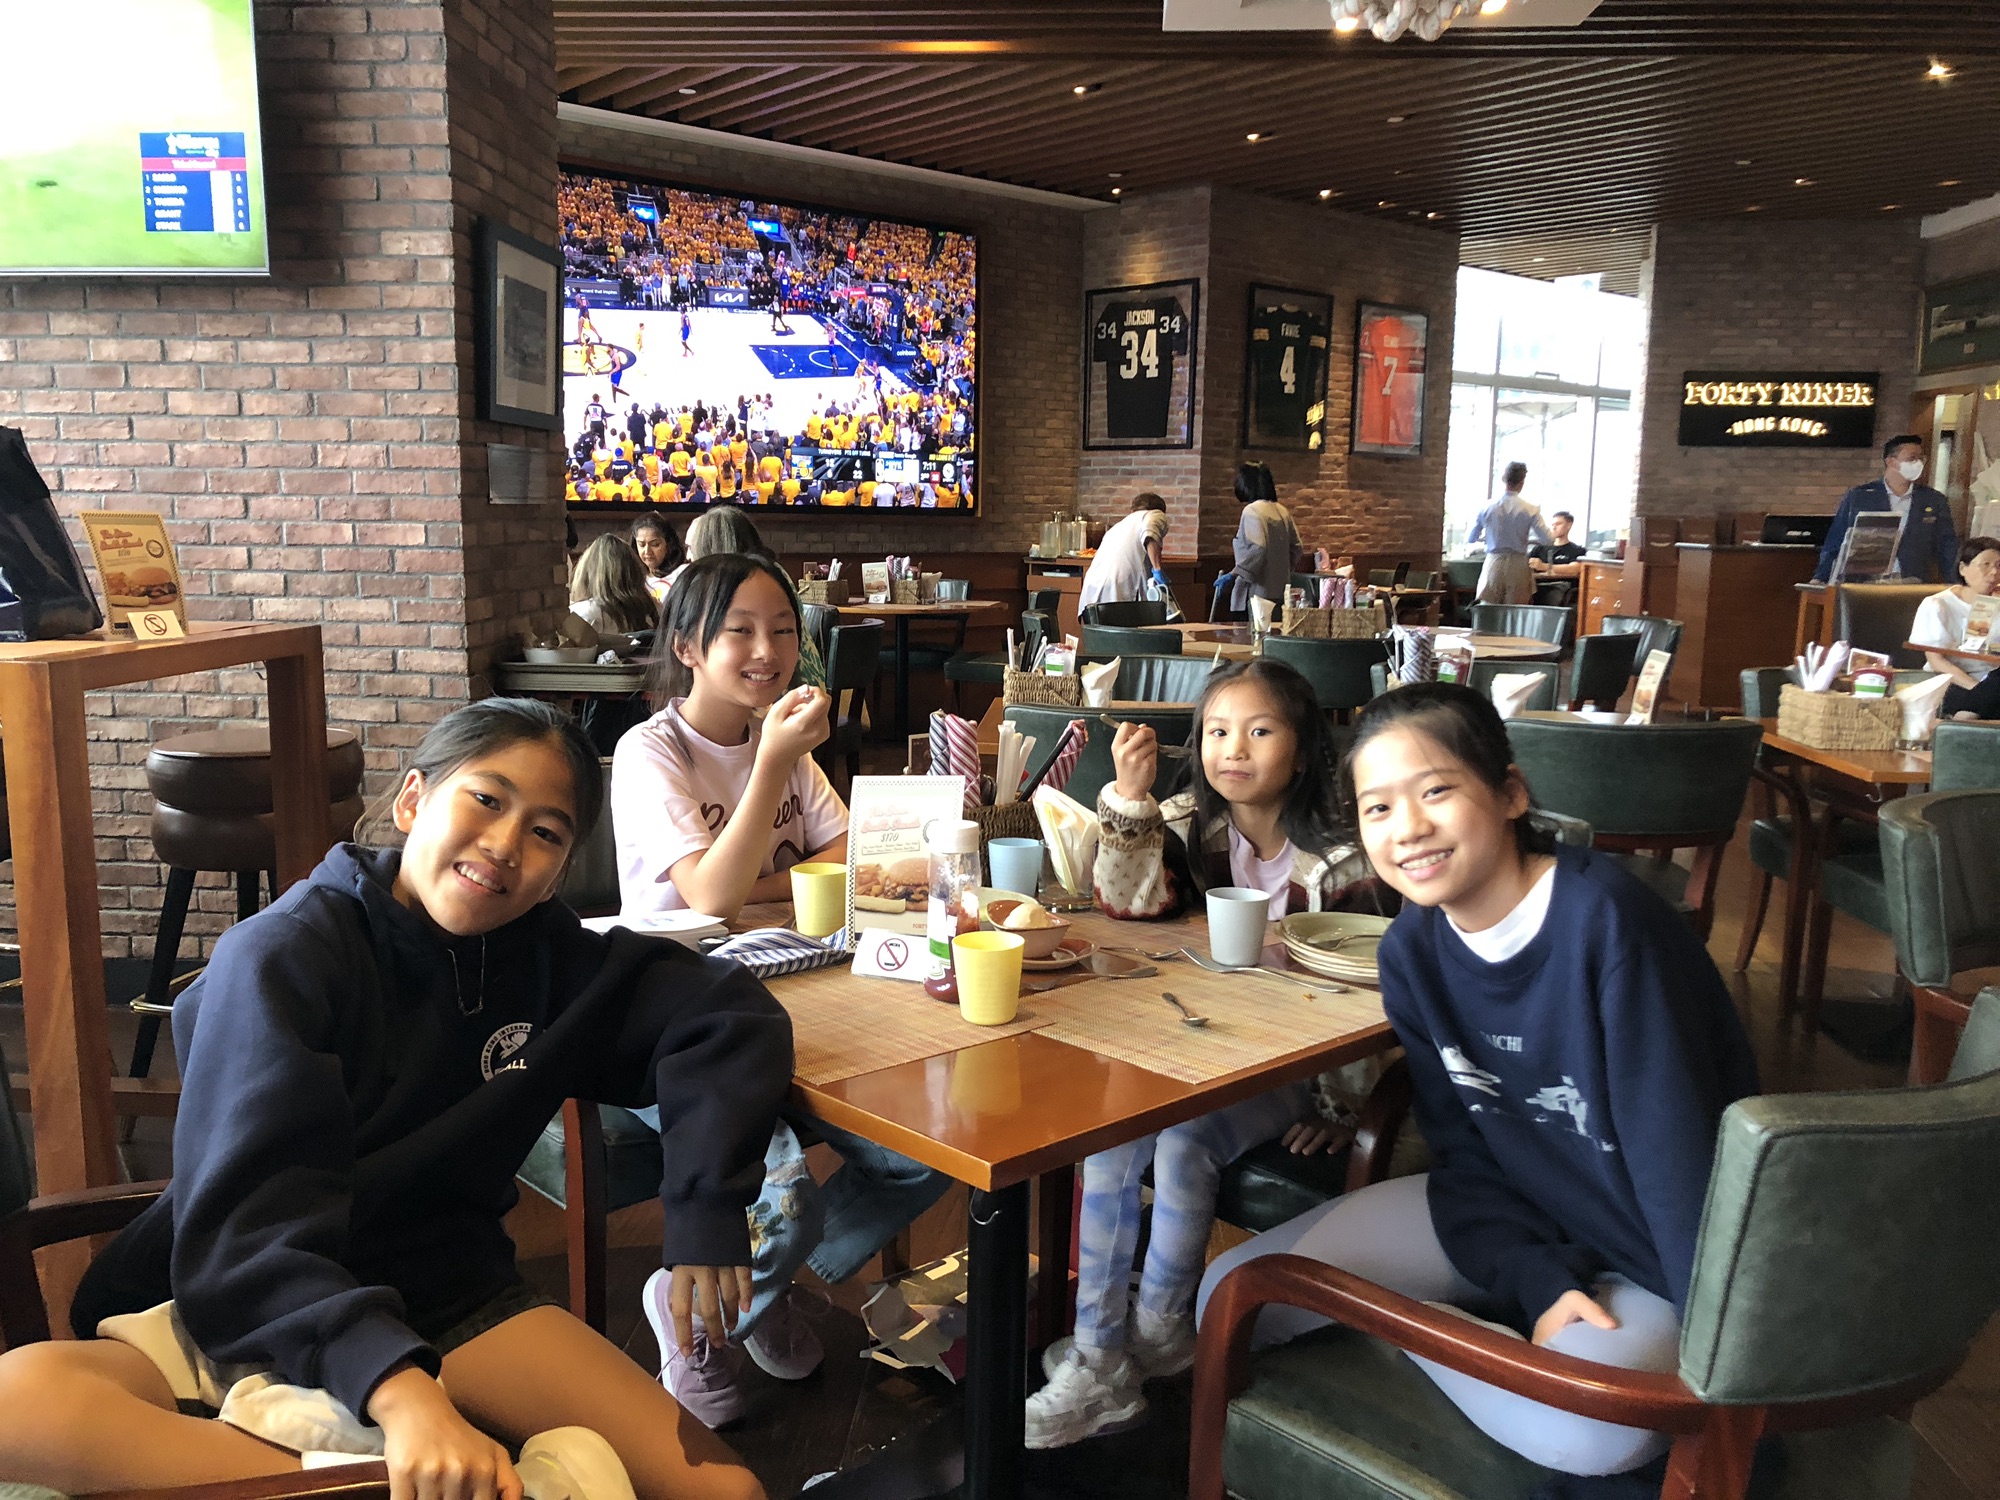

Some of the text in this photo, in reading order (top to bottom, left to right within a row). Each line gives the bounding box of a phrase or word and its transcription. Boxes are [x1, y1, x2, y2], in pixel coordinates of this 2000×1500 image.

[1123, 308, 1155, 326] JACKSON
[1159, 315, 1181, 334] 34
[1096, 320, 1117, 339] 34
[1119, 328, 1160, 380] 34
[1279, 346, 1296, 394] 4
[1382, 356, 1398, 396] 7
[1684, 381, 1778, 406] FORTY
[1732, 416, 1825, 437] HONG KONG
[922, 462, 936, 470] 7:11
[881, 832, 899, 843] $170
